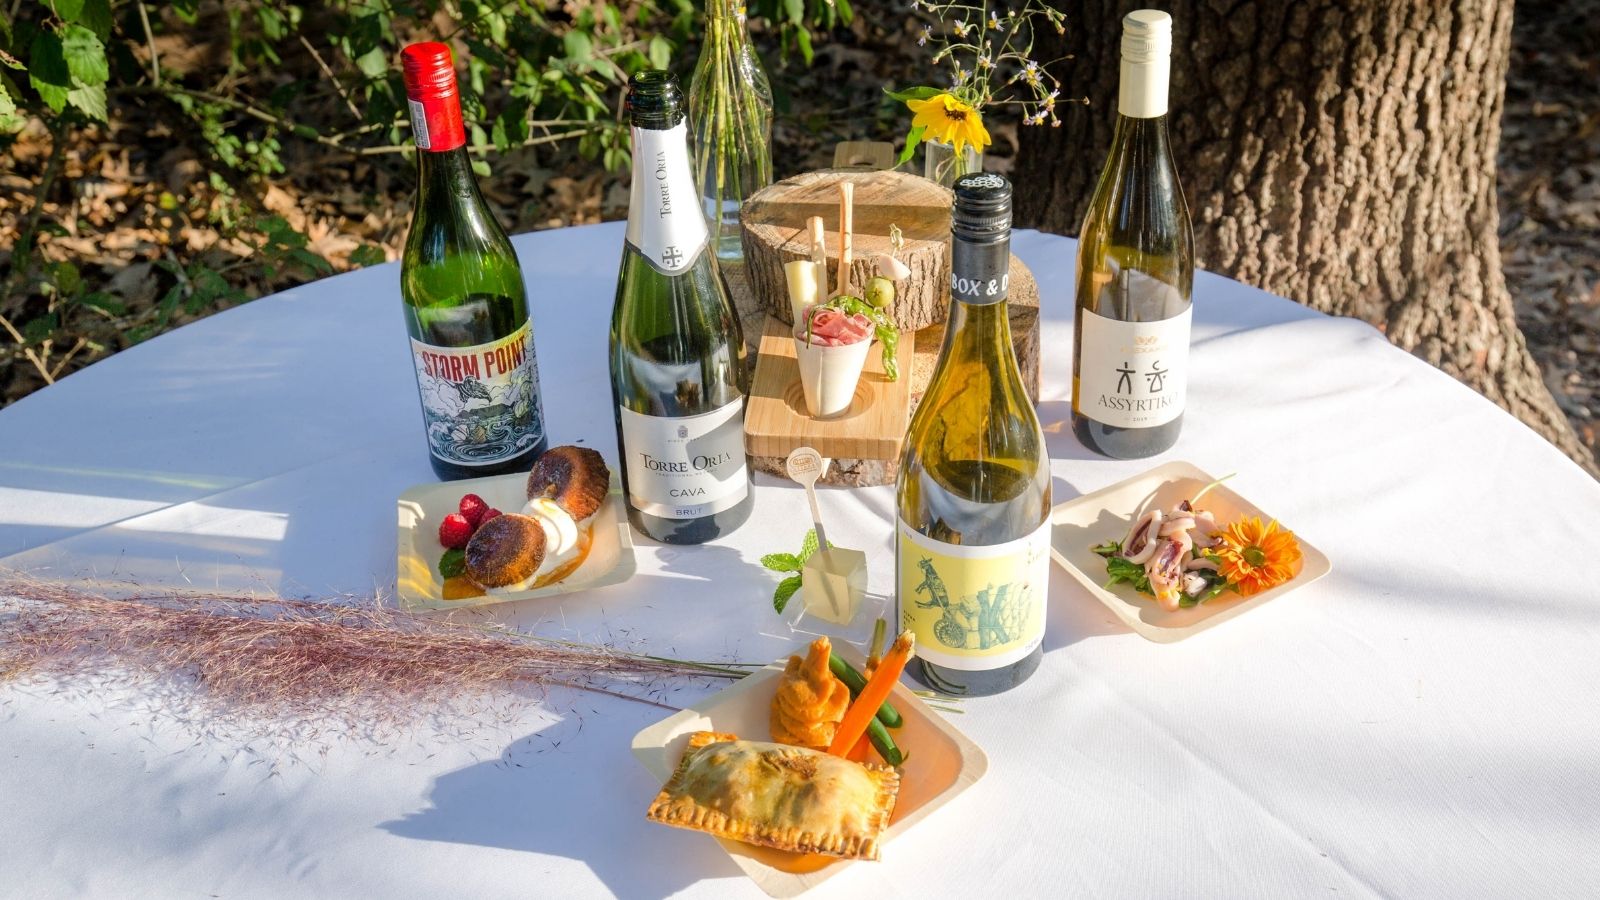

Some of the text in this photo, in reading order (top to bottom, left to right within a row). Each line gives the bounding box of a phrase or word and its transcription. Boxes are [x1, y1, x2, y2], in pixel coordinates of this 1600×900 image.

[655, 151, 672, 219] TORRE ORIA
[986, 279, 998, 296] &
[421, 335, 526, 382] STORM POINT
[640, 452, 731, 473] TORRE ORIA
[669, 487, 706, 498] CAVA
[675, 508, 703, 516] BRUT
